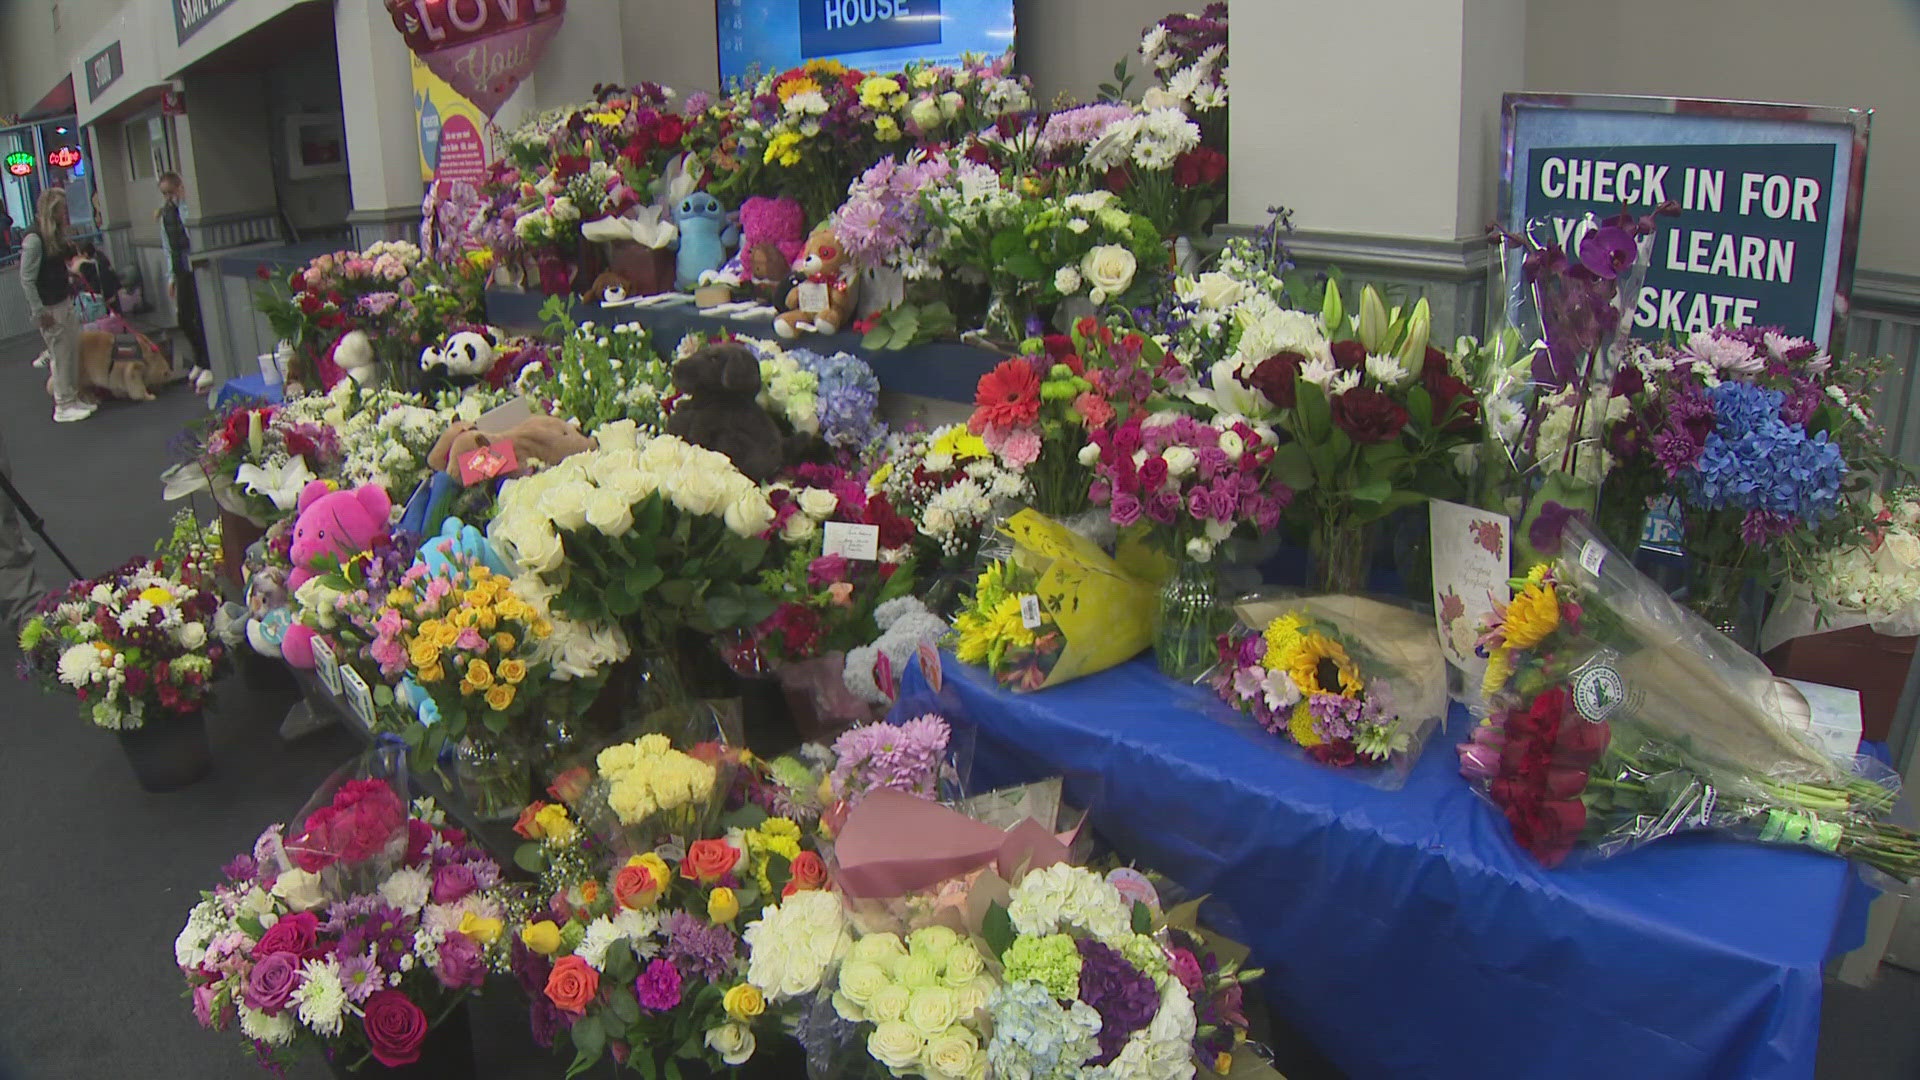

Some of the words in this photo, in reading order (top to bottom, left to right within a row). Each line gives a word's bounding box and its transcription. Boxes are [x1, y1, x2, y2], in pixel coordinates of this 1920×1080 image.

[415, 0, 550, 41] LOV
[825, 0, 909, 30] HOUSE
[7, 152, 33, 166] PIZZA
[1541, 157, 1670, 206] CHECK
[1683, 168, 1725, 213] IN
[1739, 173, 1822, 222] FOR
[1666, 228, 1795, 284] LEARN
